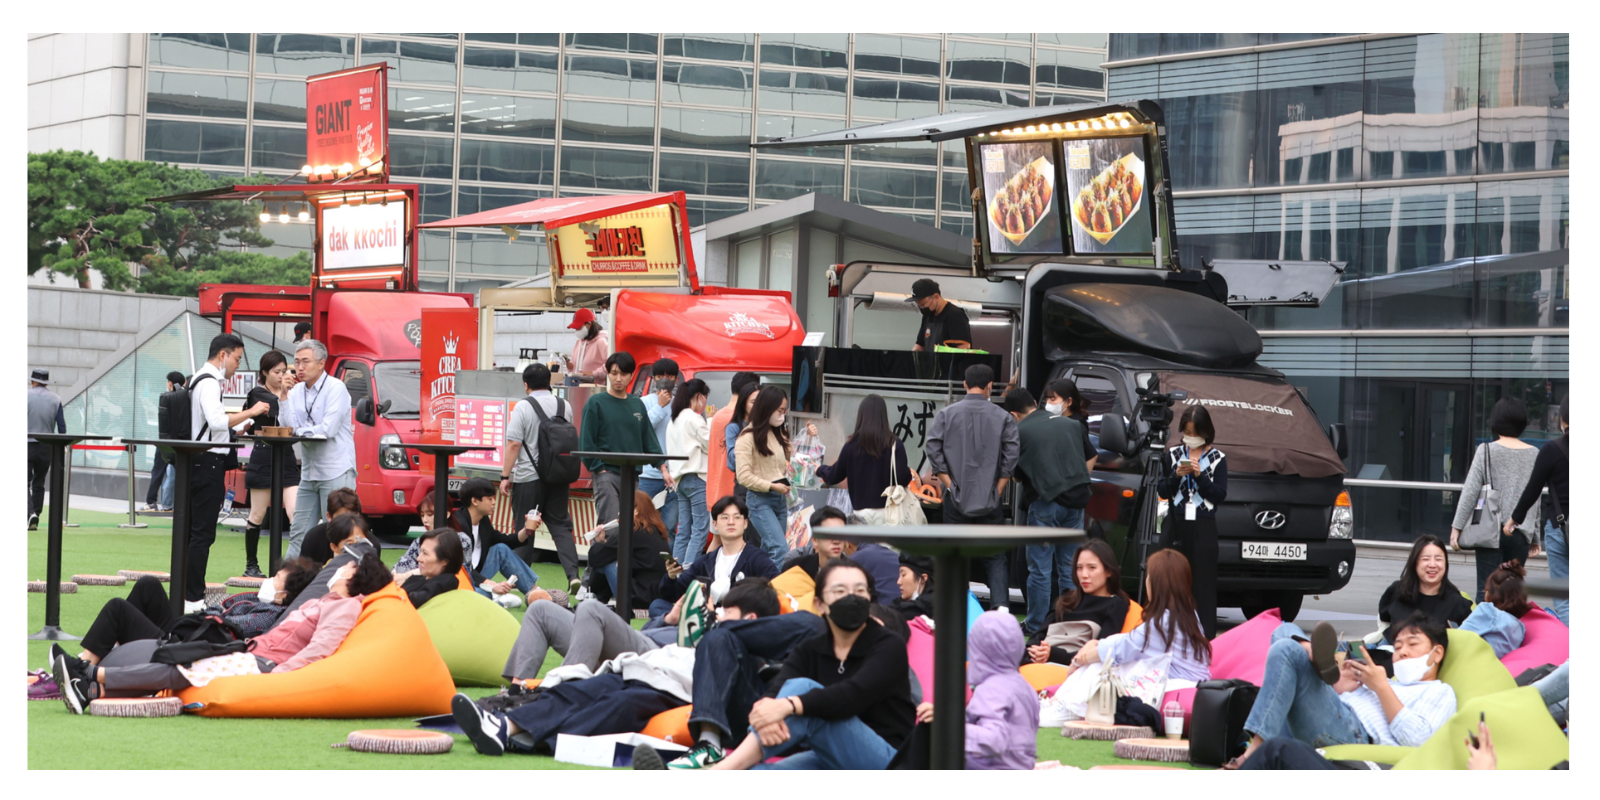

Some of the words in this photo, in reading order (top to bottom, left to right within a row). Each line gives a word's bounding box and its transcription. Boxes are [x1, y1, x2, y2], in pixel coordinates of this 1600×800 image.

[316, 99, 352, 136] GIANT
[329, 225, 349, 252] dak
[354, 219, 397, 250] kkochi
[615, 262, 630, 270] COFFEE
[634, 261, 647, 270] DRINK
[438, 355, 462, 375] CREA
[1200, 398, 1294, 416] FROSTBLOCKER
[1248, 544, 1268, 556] 94마
[1274, 545, 1301, 558] 4450
